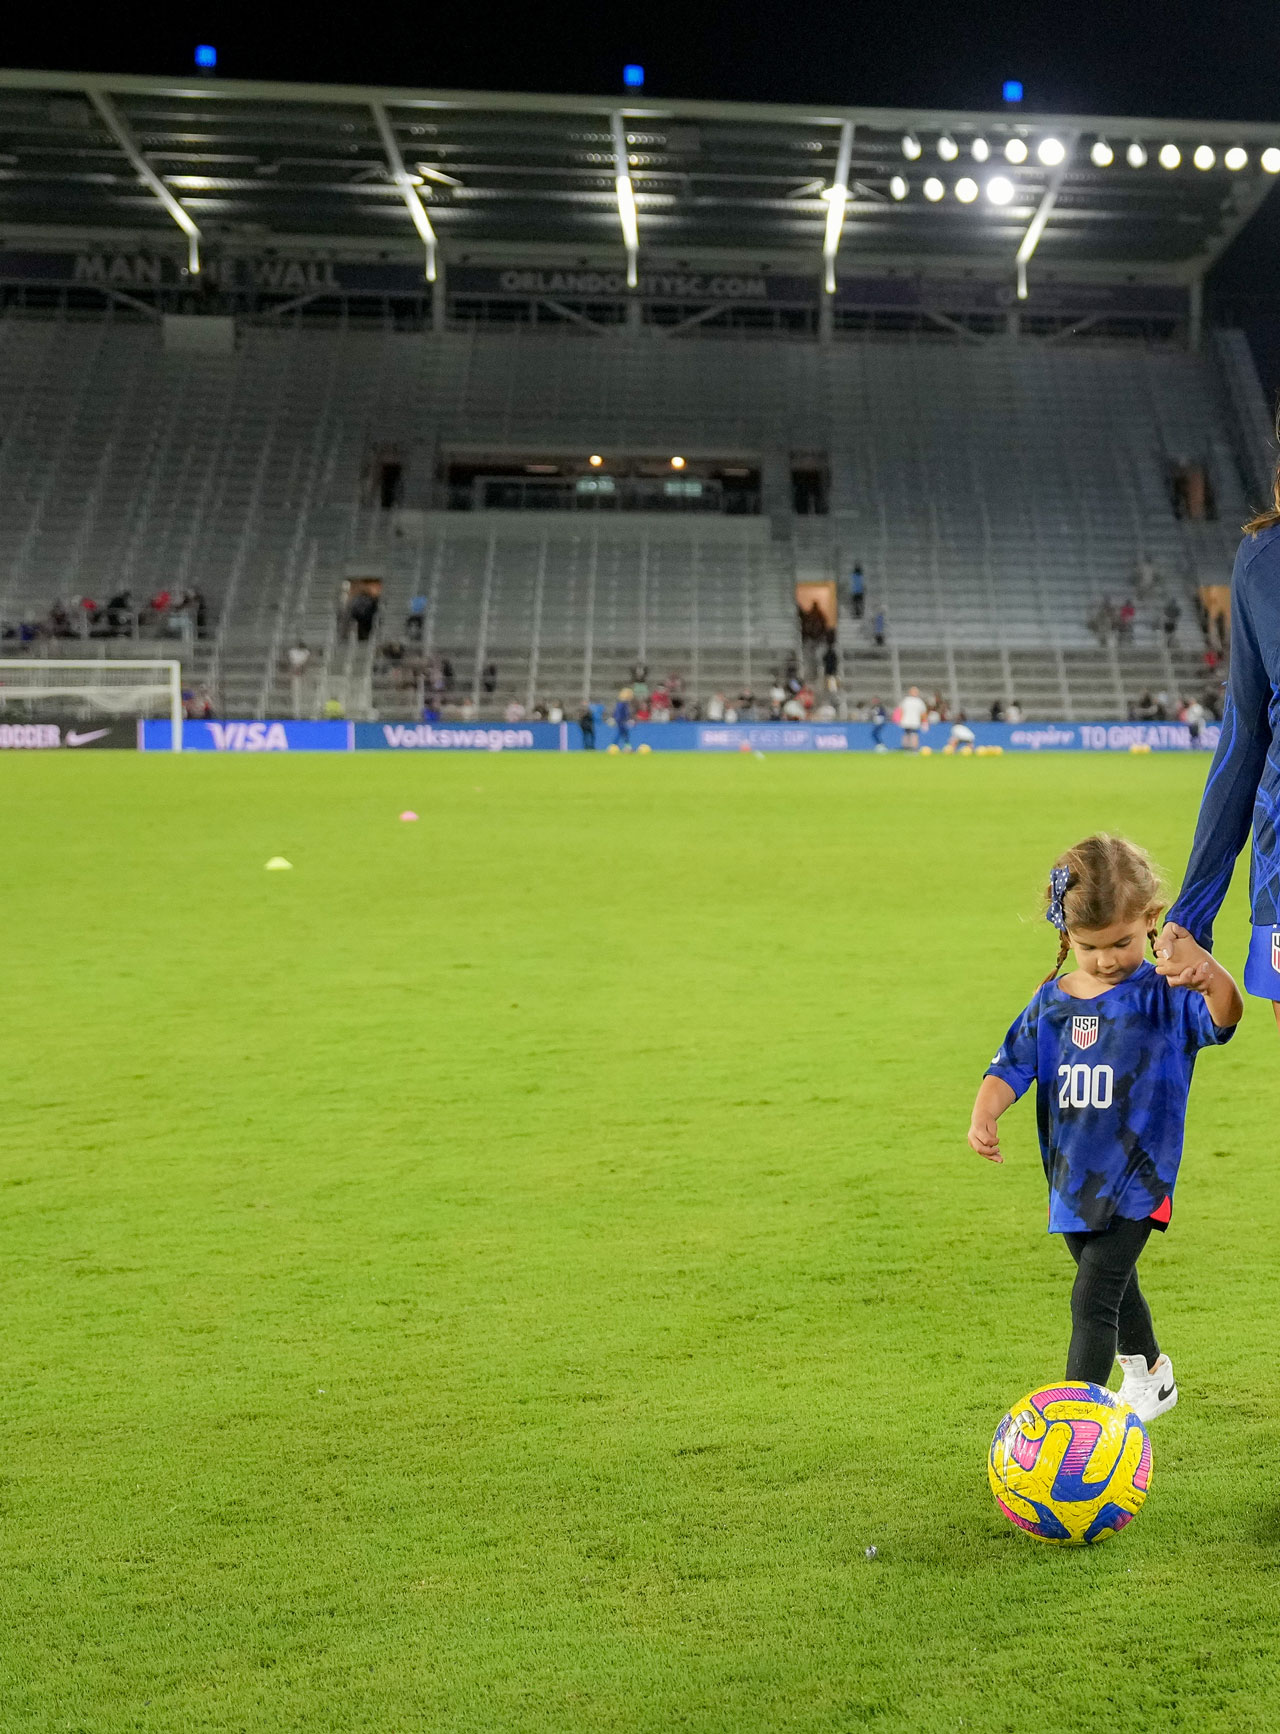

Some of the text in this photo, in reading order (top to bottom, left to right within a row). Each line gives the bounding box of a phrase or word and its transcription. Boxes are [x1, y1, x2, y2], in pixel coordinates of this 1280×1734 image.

[205, 723, 288, 750] VISA
[383, 725, 533, 751] Volkswagen
[1080, 726, 1106, 748] TO
[1074, 1017, 1098, 1031] USA
[1058, 1064, 1114, 1109] 200
